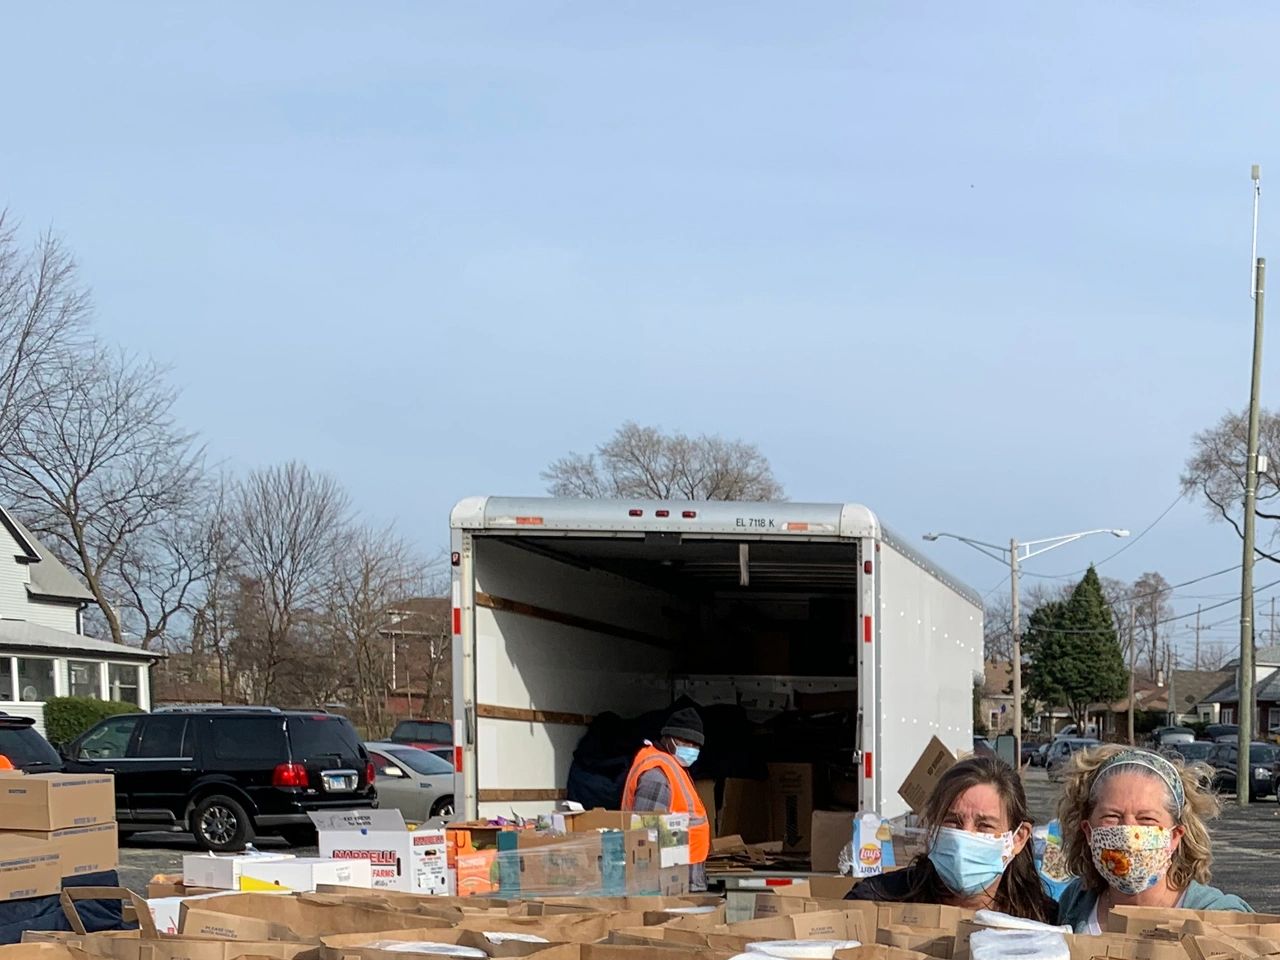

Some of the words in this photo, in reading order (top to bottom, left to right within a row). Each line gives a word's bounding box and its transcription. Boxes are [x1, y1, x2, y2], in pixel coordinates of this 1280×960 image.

[736, 518, 746, 527] EL
[749, 518, 766, 528] 7118
[769, 518, 775, 528] K
[372, 869, 395, 878] FARMS
